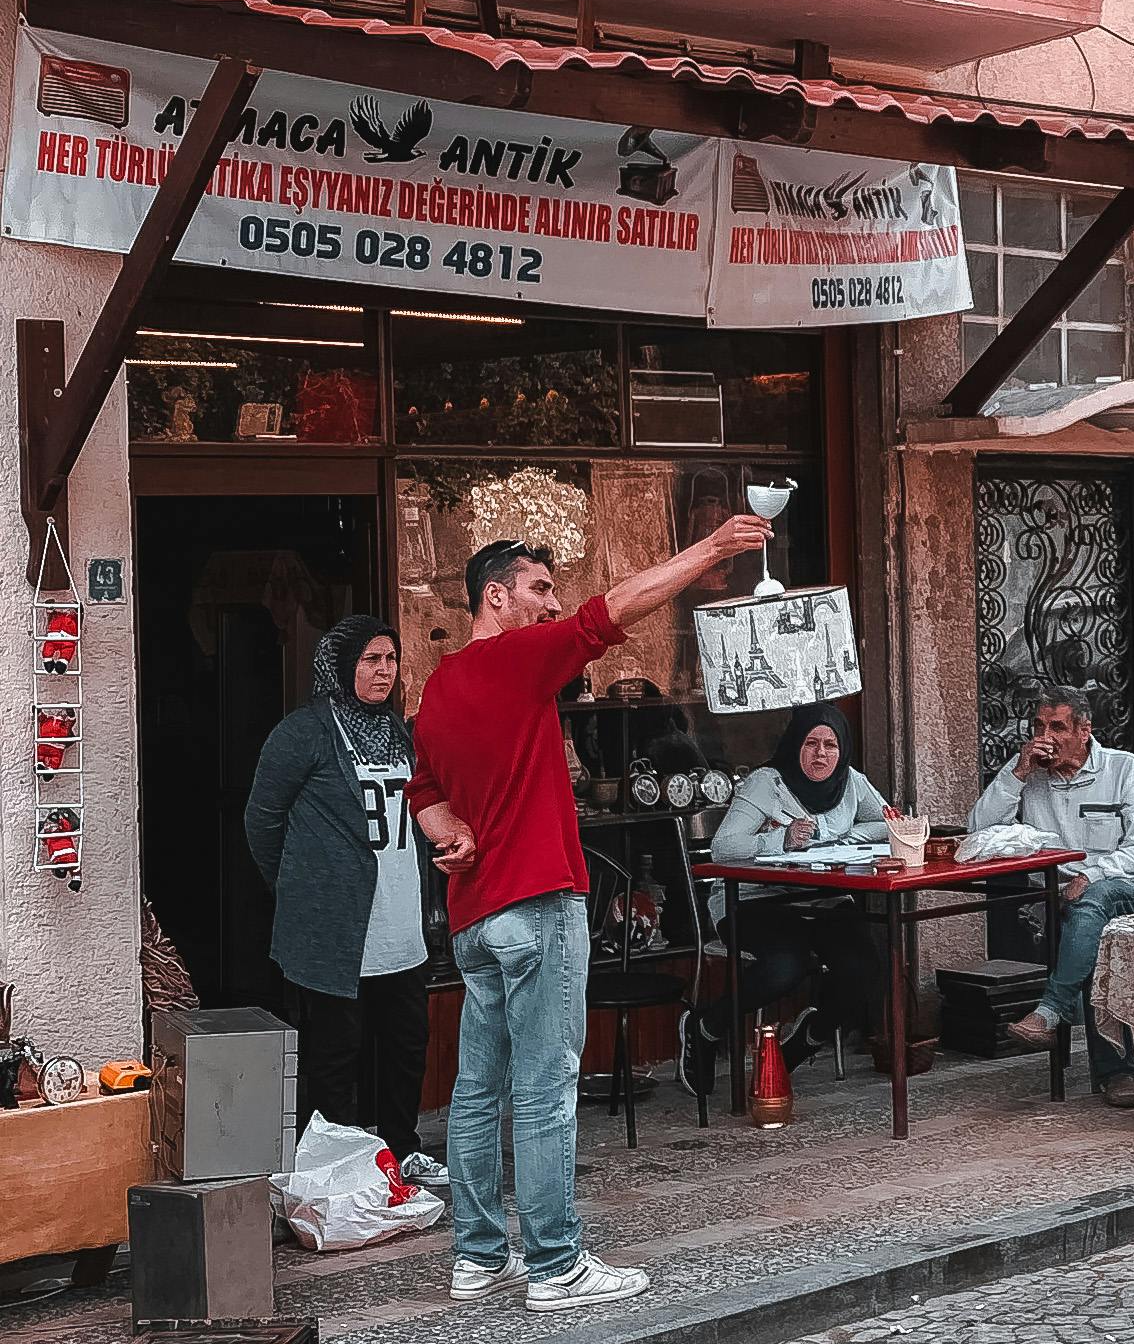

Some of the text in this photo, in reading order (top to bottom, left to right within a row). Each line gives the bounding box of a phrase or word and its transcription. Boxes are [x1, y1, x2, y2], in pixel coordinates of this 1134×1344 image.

[153, 95, 583, 189] AMACA ANTİK
[37, 130, 89, 177] HER
[278, 164, 394, 218] EŞYYANIZ
[397, 176, 532, 234] DEĞERİNDE
[533, 196, 613, 243] ALINIR
[616, 205, 700, 252] SATILIR
[239, 215, 544, 284] 0505 028 4812
[811, 275, 904, 309] 0505 028 4812
